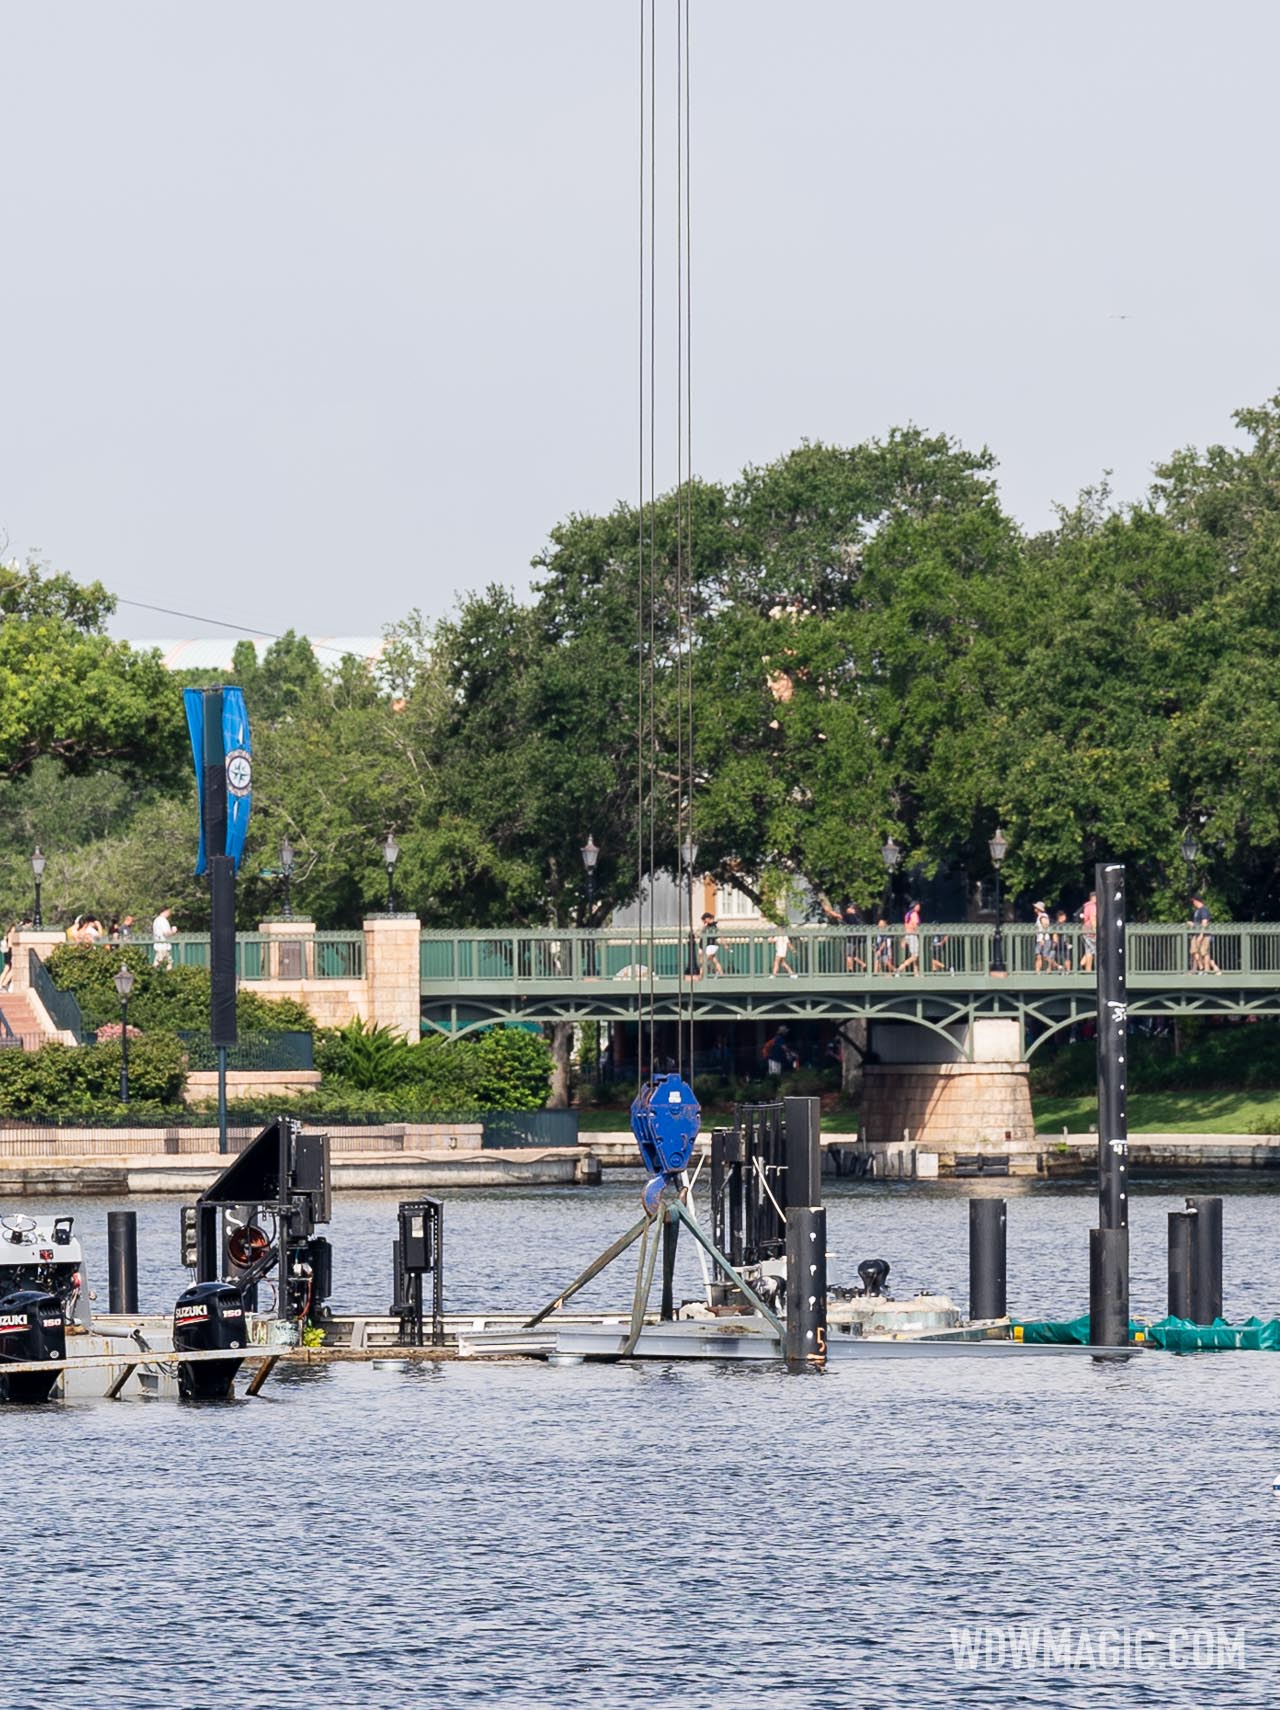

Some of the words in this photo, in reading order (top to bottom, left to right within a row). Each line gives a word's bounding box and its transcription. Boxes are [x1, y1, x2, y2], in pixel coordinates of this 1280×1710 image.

[175, 1304, 208, 1319] SUZUKI
[223, 1309, 242, 1318] 150
[43, 1318, 62, 1328] 150
